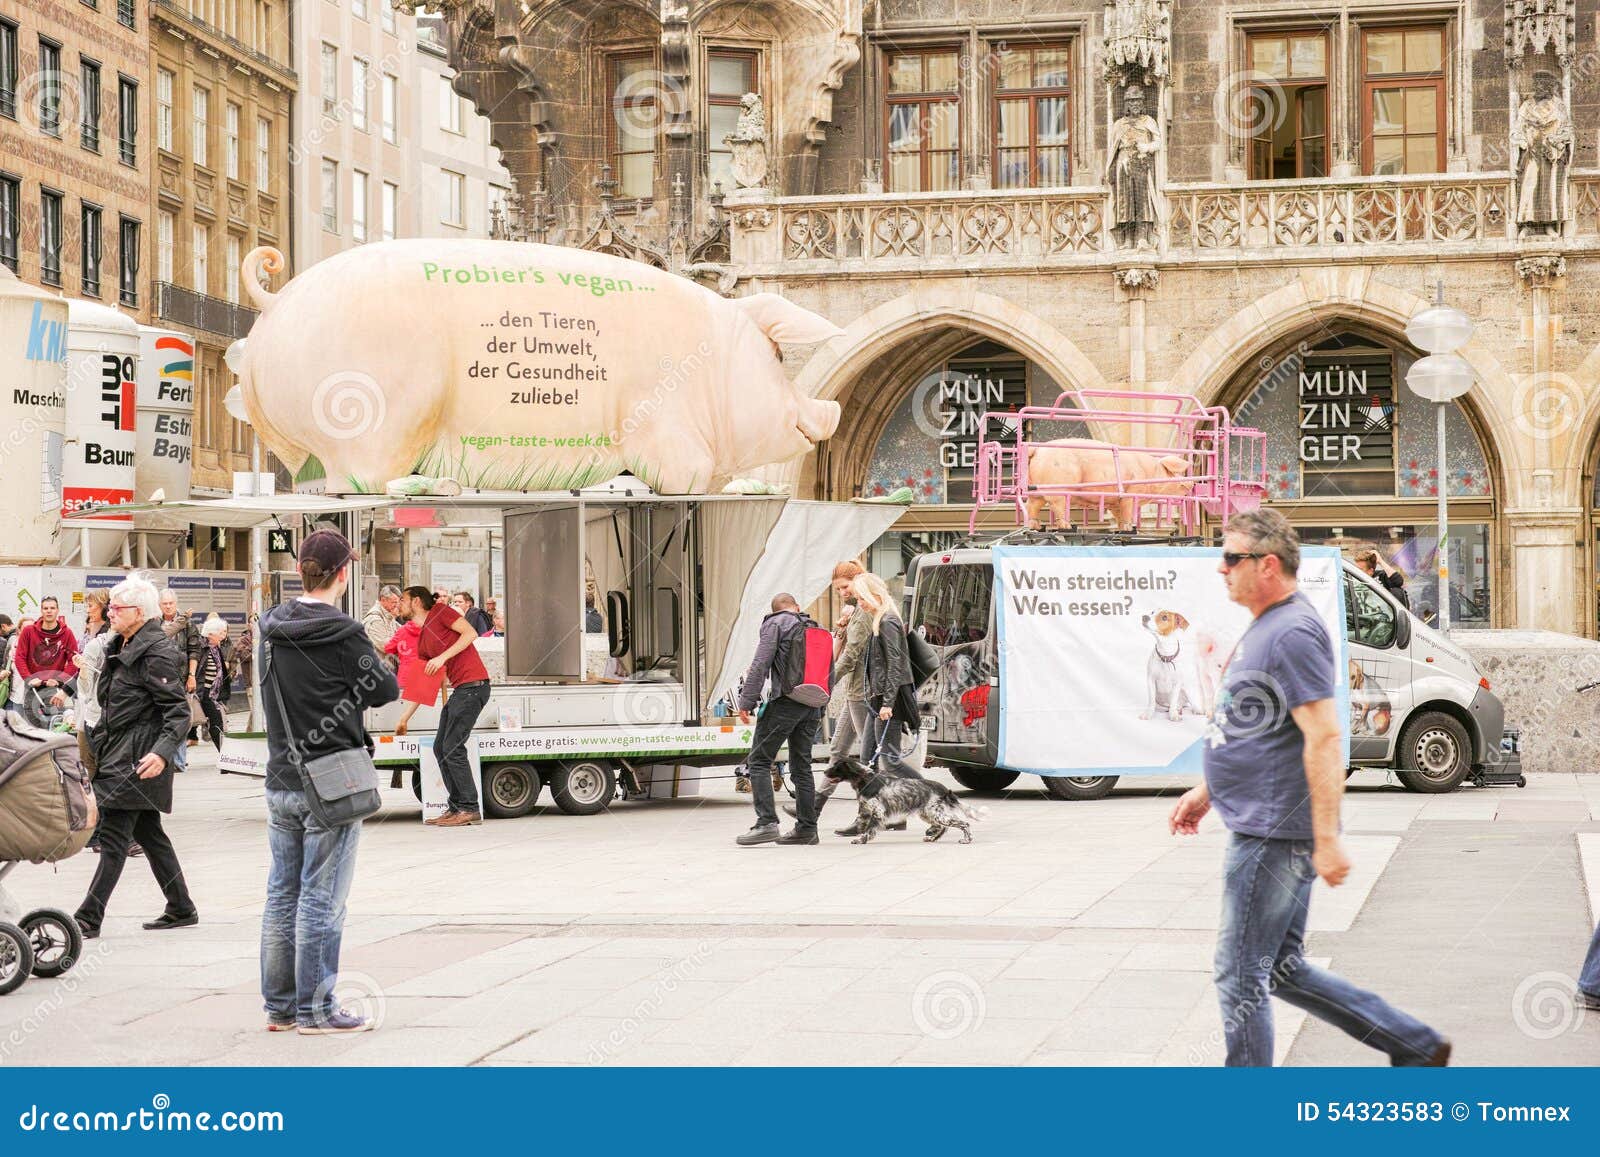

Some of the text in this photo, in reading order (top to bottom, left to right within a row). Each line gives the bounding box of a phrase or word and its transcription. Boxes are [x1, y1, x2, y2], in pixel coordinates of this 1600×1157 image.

[423, 262, 545, 284] Probier's
[500, 311, 533, 328] den
[539, 312, 601, 337] Tieren,
[486, 336, 597, 361] der Umwelt,
[468, 361, 608, 382] der Gesundheit
[1300, 365, 1367, 396] MÜN
[510, 387, 579, 405] zuliebe!
[939, 374, 1004, 404] MÜN
[1300, 403, 1351, 429] ZIN
[460, 433, 612, 450] vegan-taste-week.de
[1300, 435, 1362, 462] GER
[1010, 569, 1177, 590] Wen streicheln?
[1012, 595, 1133, 616] Wen essen?
[399, 741, 420, 754] Tip
[499, 738, 542, 750] Rezepte
[545, 736, 578, 752] gratis:
[580, 732, 717, 747] www.vegan-taste-week.de
